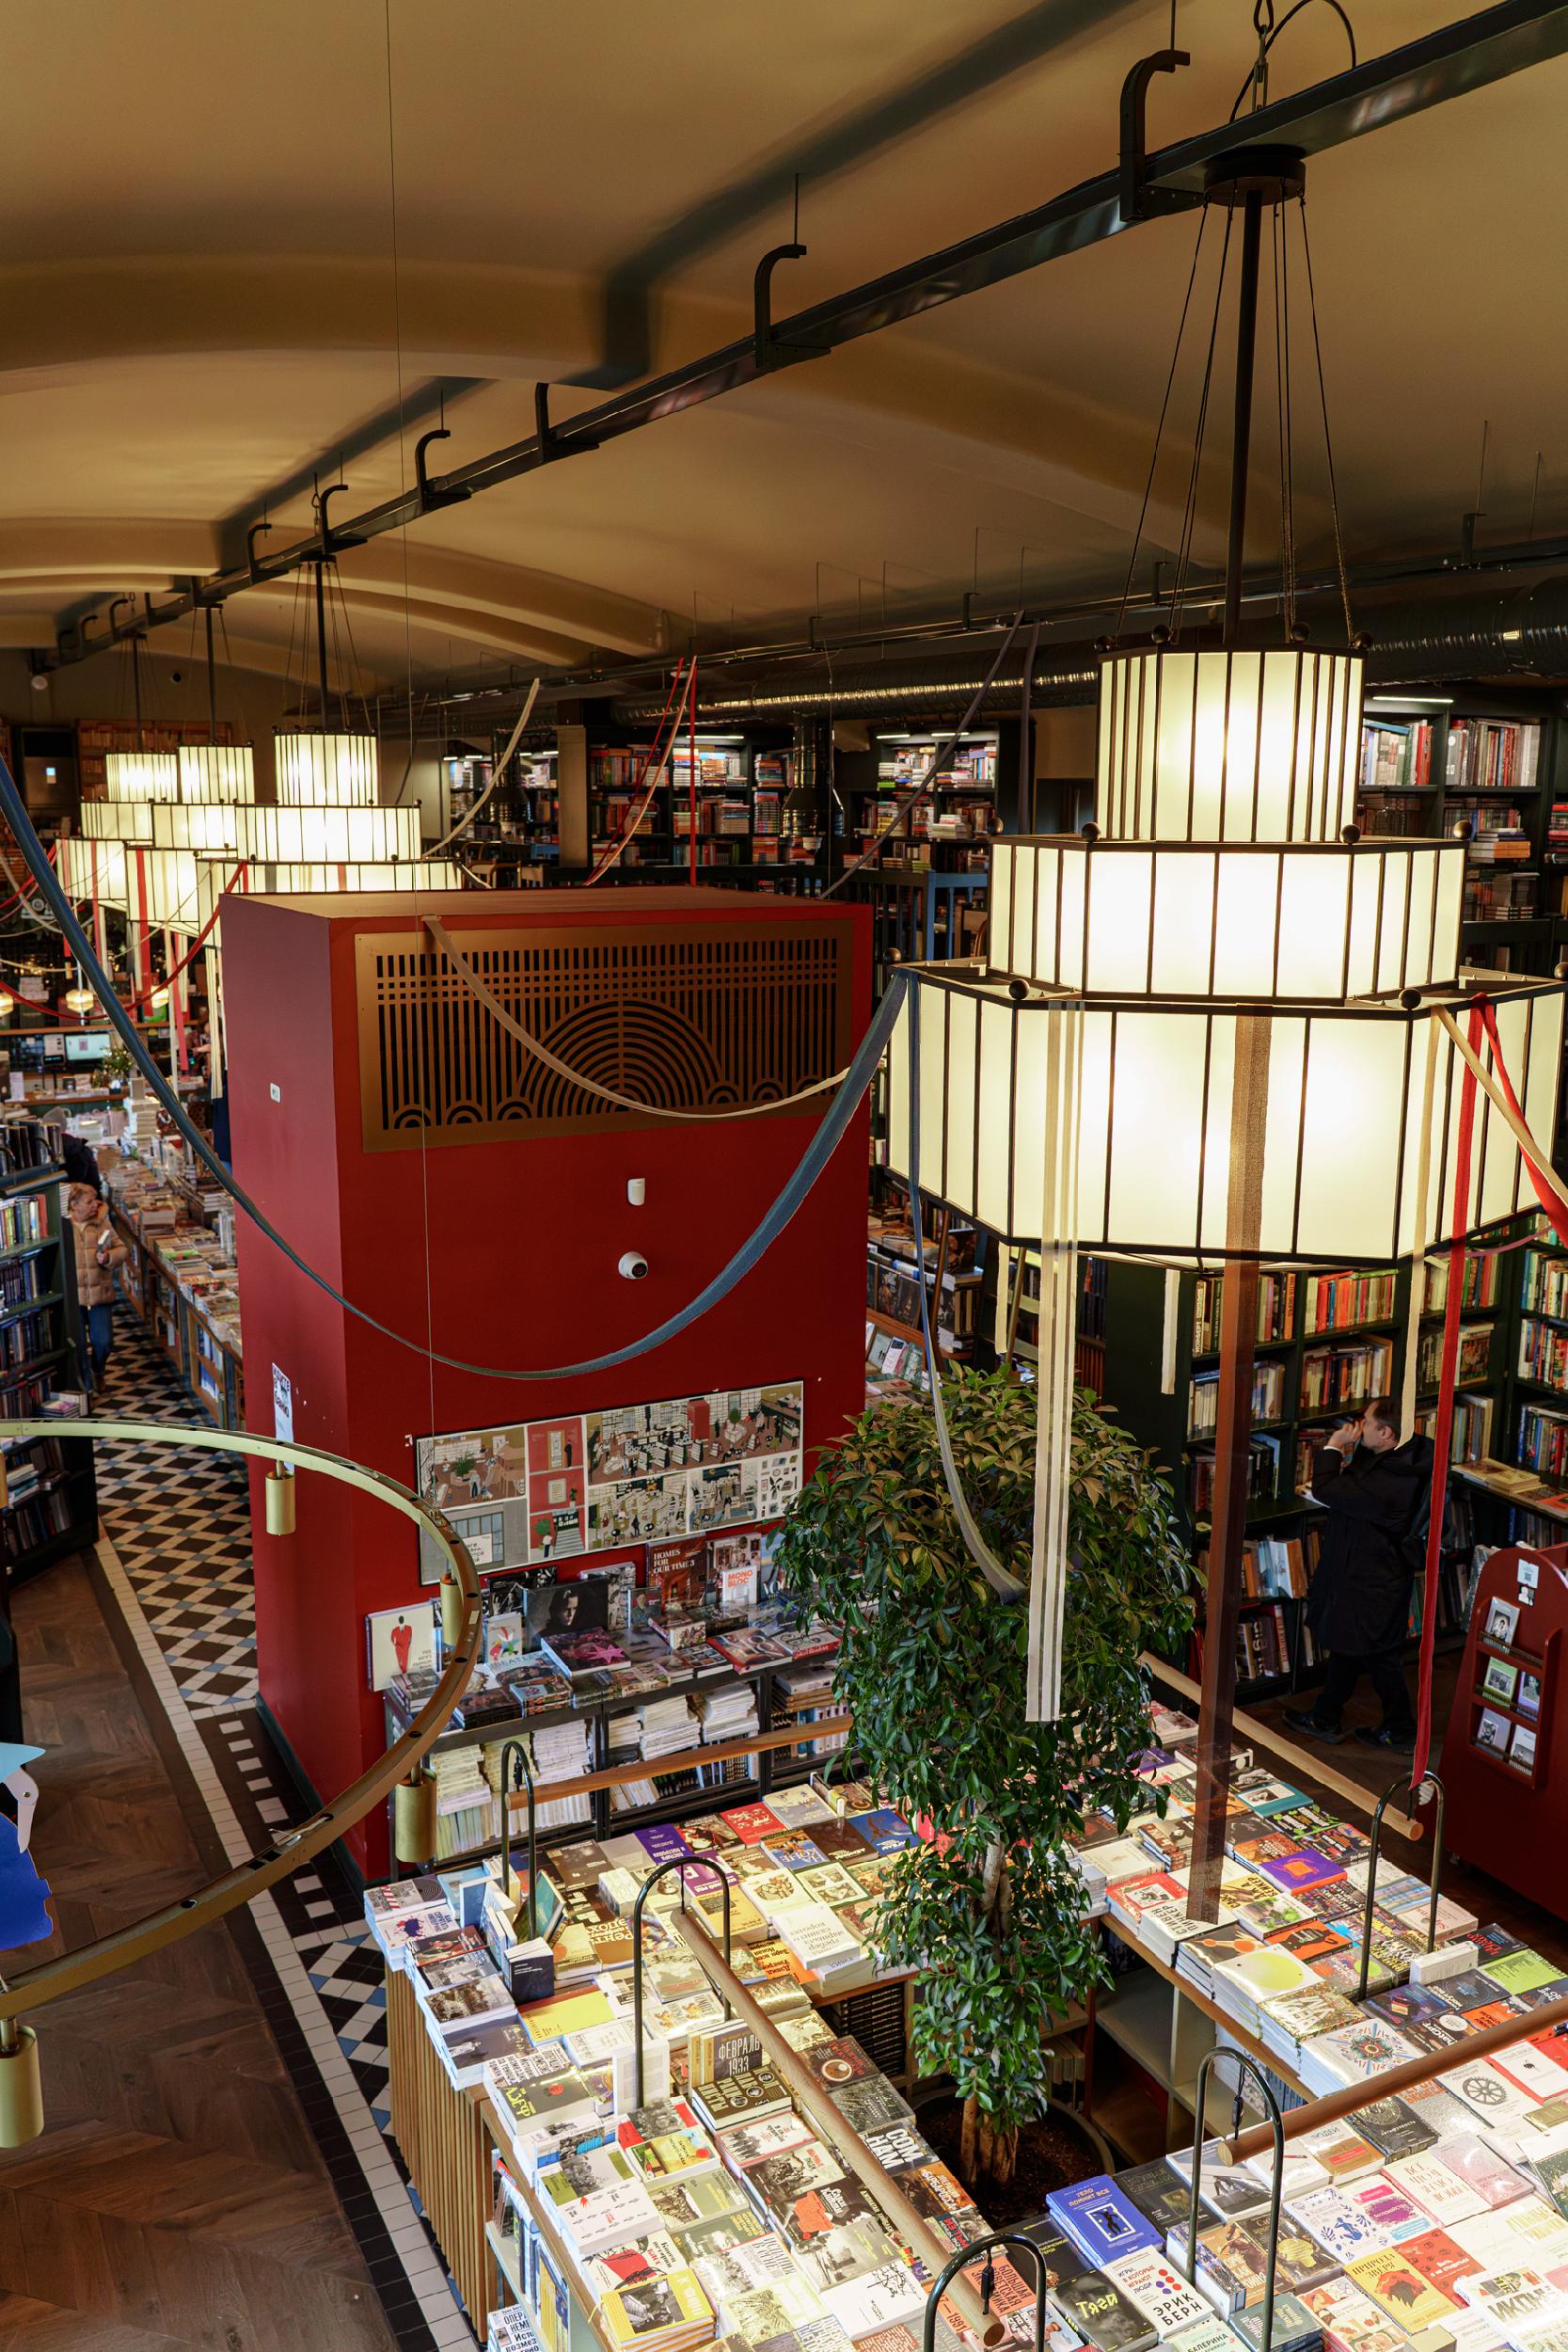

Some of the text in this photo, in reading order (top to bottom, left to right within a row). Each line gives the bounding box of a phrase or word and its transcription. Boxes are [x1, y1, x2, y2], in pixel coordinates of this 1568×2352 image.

[653, 1549, 681, 1560] HOMES
[653, 1558, 669, 1566] FOR
[653, 1565, 671, 1574] OUR
[671, 1562, 689, 1572] TIME
[727, 1569, 753, 1580] MONO
[727, 1577, 750, 1587] BLOC
[719, 2033, 760, 2061] ФЕВРАЛЬ
[728, 2057, 751, 2077] 1933
[505, 2086, 534, 2118] АЗЕФ
[885, 2128, 924, 2163] СОМ
[1068, 2193, 1096, 2207] ПОМНИТ
[1075, 2188, 1094, 2198] ТЕЛО
[1118, 2266, 1136, 2278] ИГРЫ,
[1129, 2265, 1156, 2280] КОТОРЫЕ
[998, 2264, 1032, 2299] БОЛЬШАЯ
[1127, 2274, 1152, 2288] ИГРАЮТ
[1133, 2281, 1153, 2294] ЛЮДИ
[1152, 2293, 1194, 2316] ЭРИК
[1161, 2300, 1202, 2326] БЕРН
